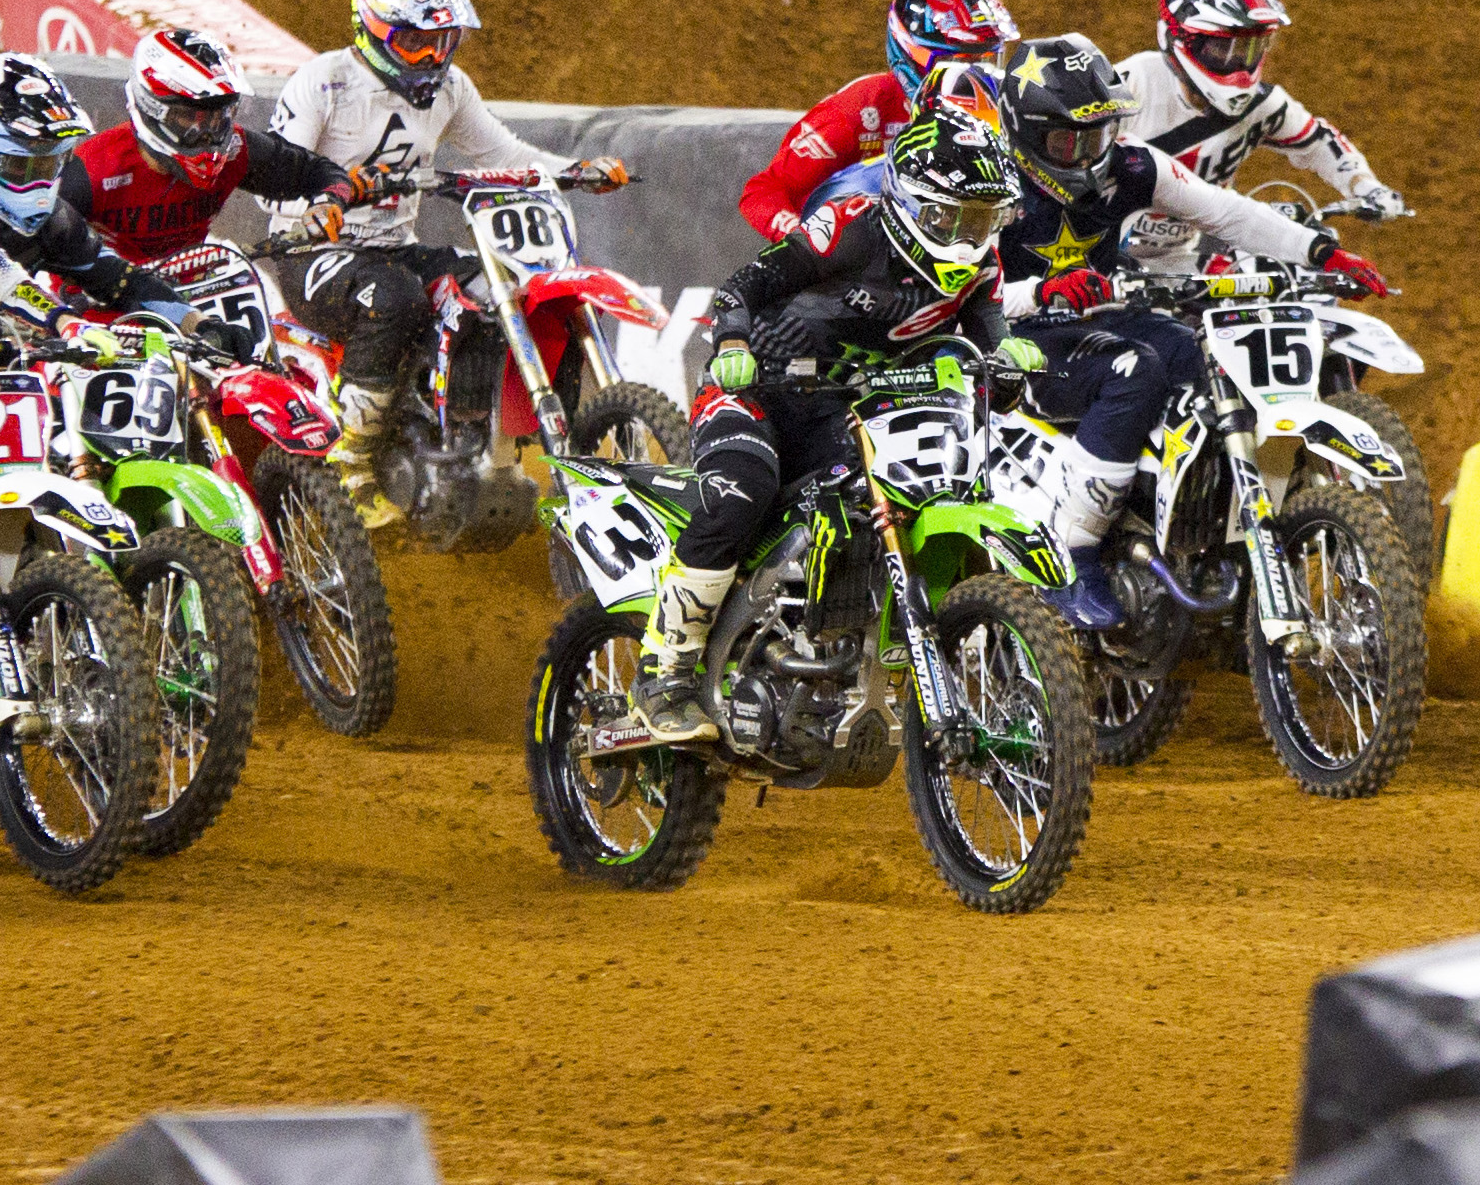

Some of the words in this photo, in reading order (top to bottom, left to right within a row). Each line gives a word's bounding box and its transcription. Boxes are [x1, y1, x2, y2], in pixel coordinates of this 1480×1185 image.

[492, 206, 554, 254] 98
[159, 248, 238, 278] ENTHAL
[871, 372, 934, 387] RENTHAL
[1234, 328, 1313, 387] 15
[80, 371, 177, 438] 69
[903, 395, 942, 405] MONSTER
[887, 410, 969, 482] 3
[575, 503, 666, 581] 3
[1260, 529, 1289, 615] DUNLOP
[906, 626, 941, 723] DUNLOP
[935, 662, 953, 718] CARRILLO
